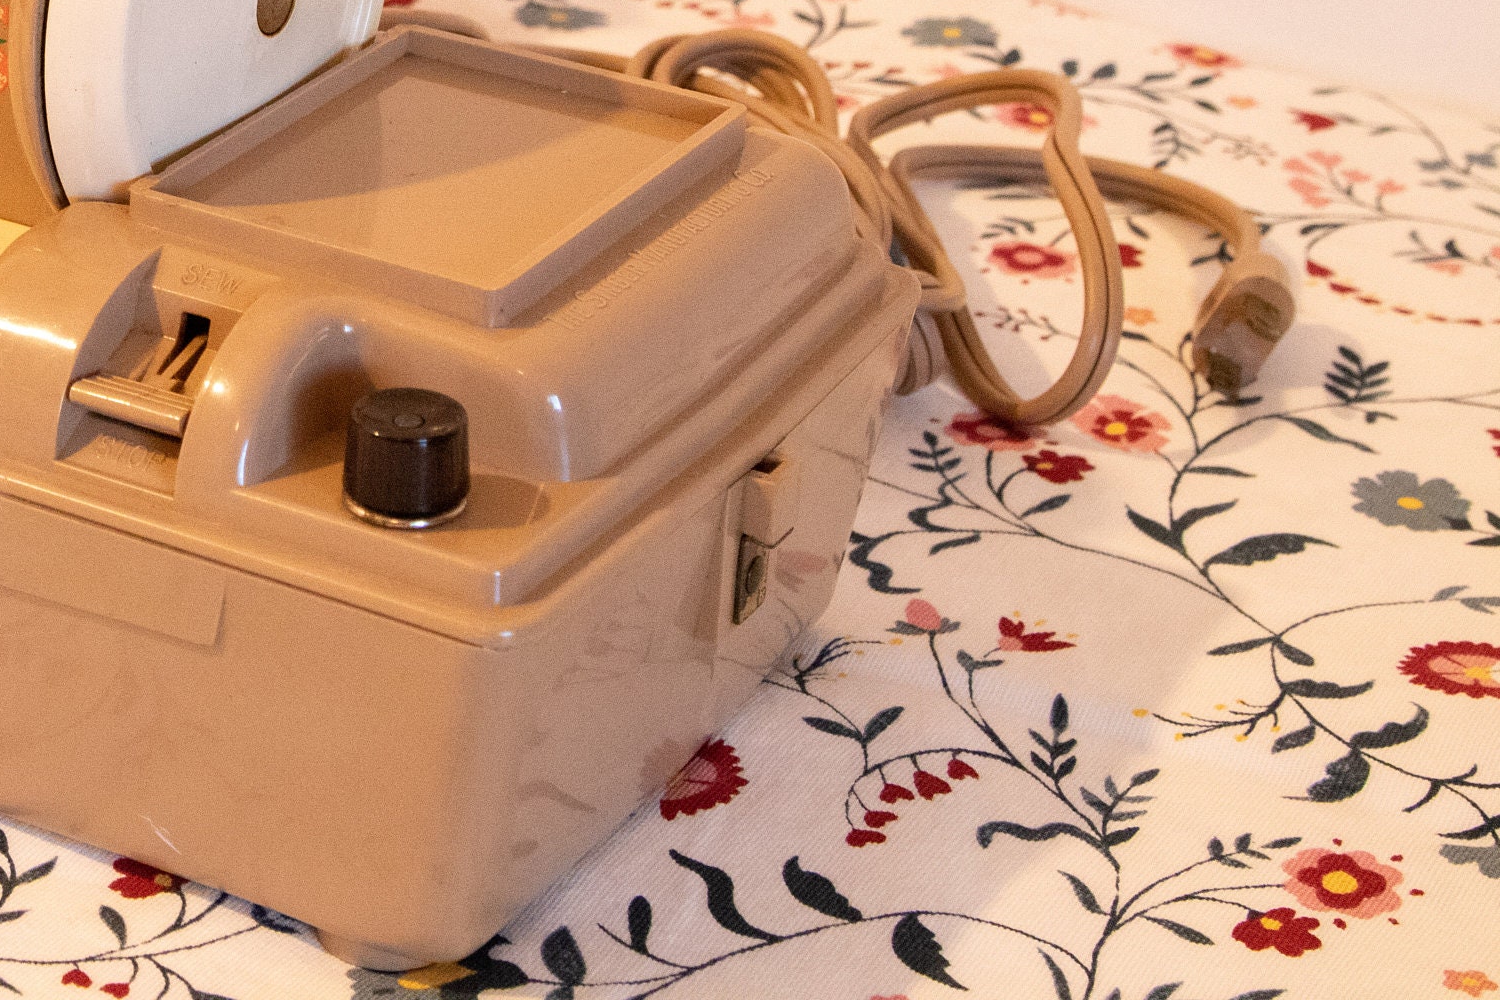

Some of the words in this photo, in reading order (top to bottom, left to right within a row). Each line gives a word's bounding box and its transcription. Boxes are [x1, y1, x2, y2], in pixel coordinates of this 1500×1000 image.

[180, 263, 245, 296] SEW
[575, 259, 650, 308] SINGER
[628, 180, 752, 265] MANUFACTURING
